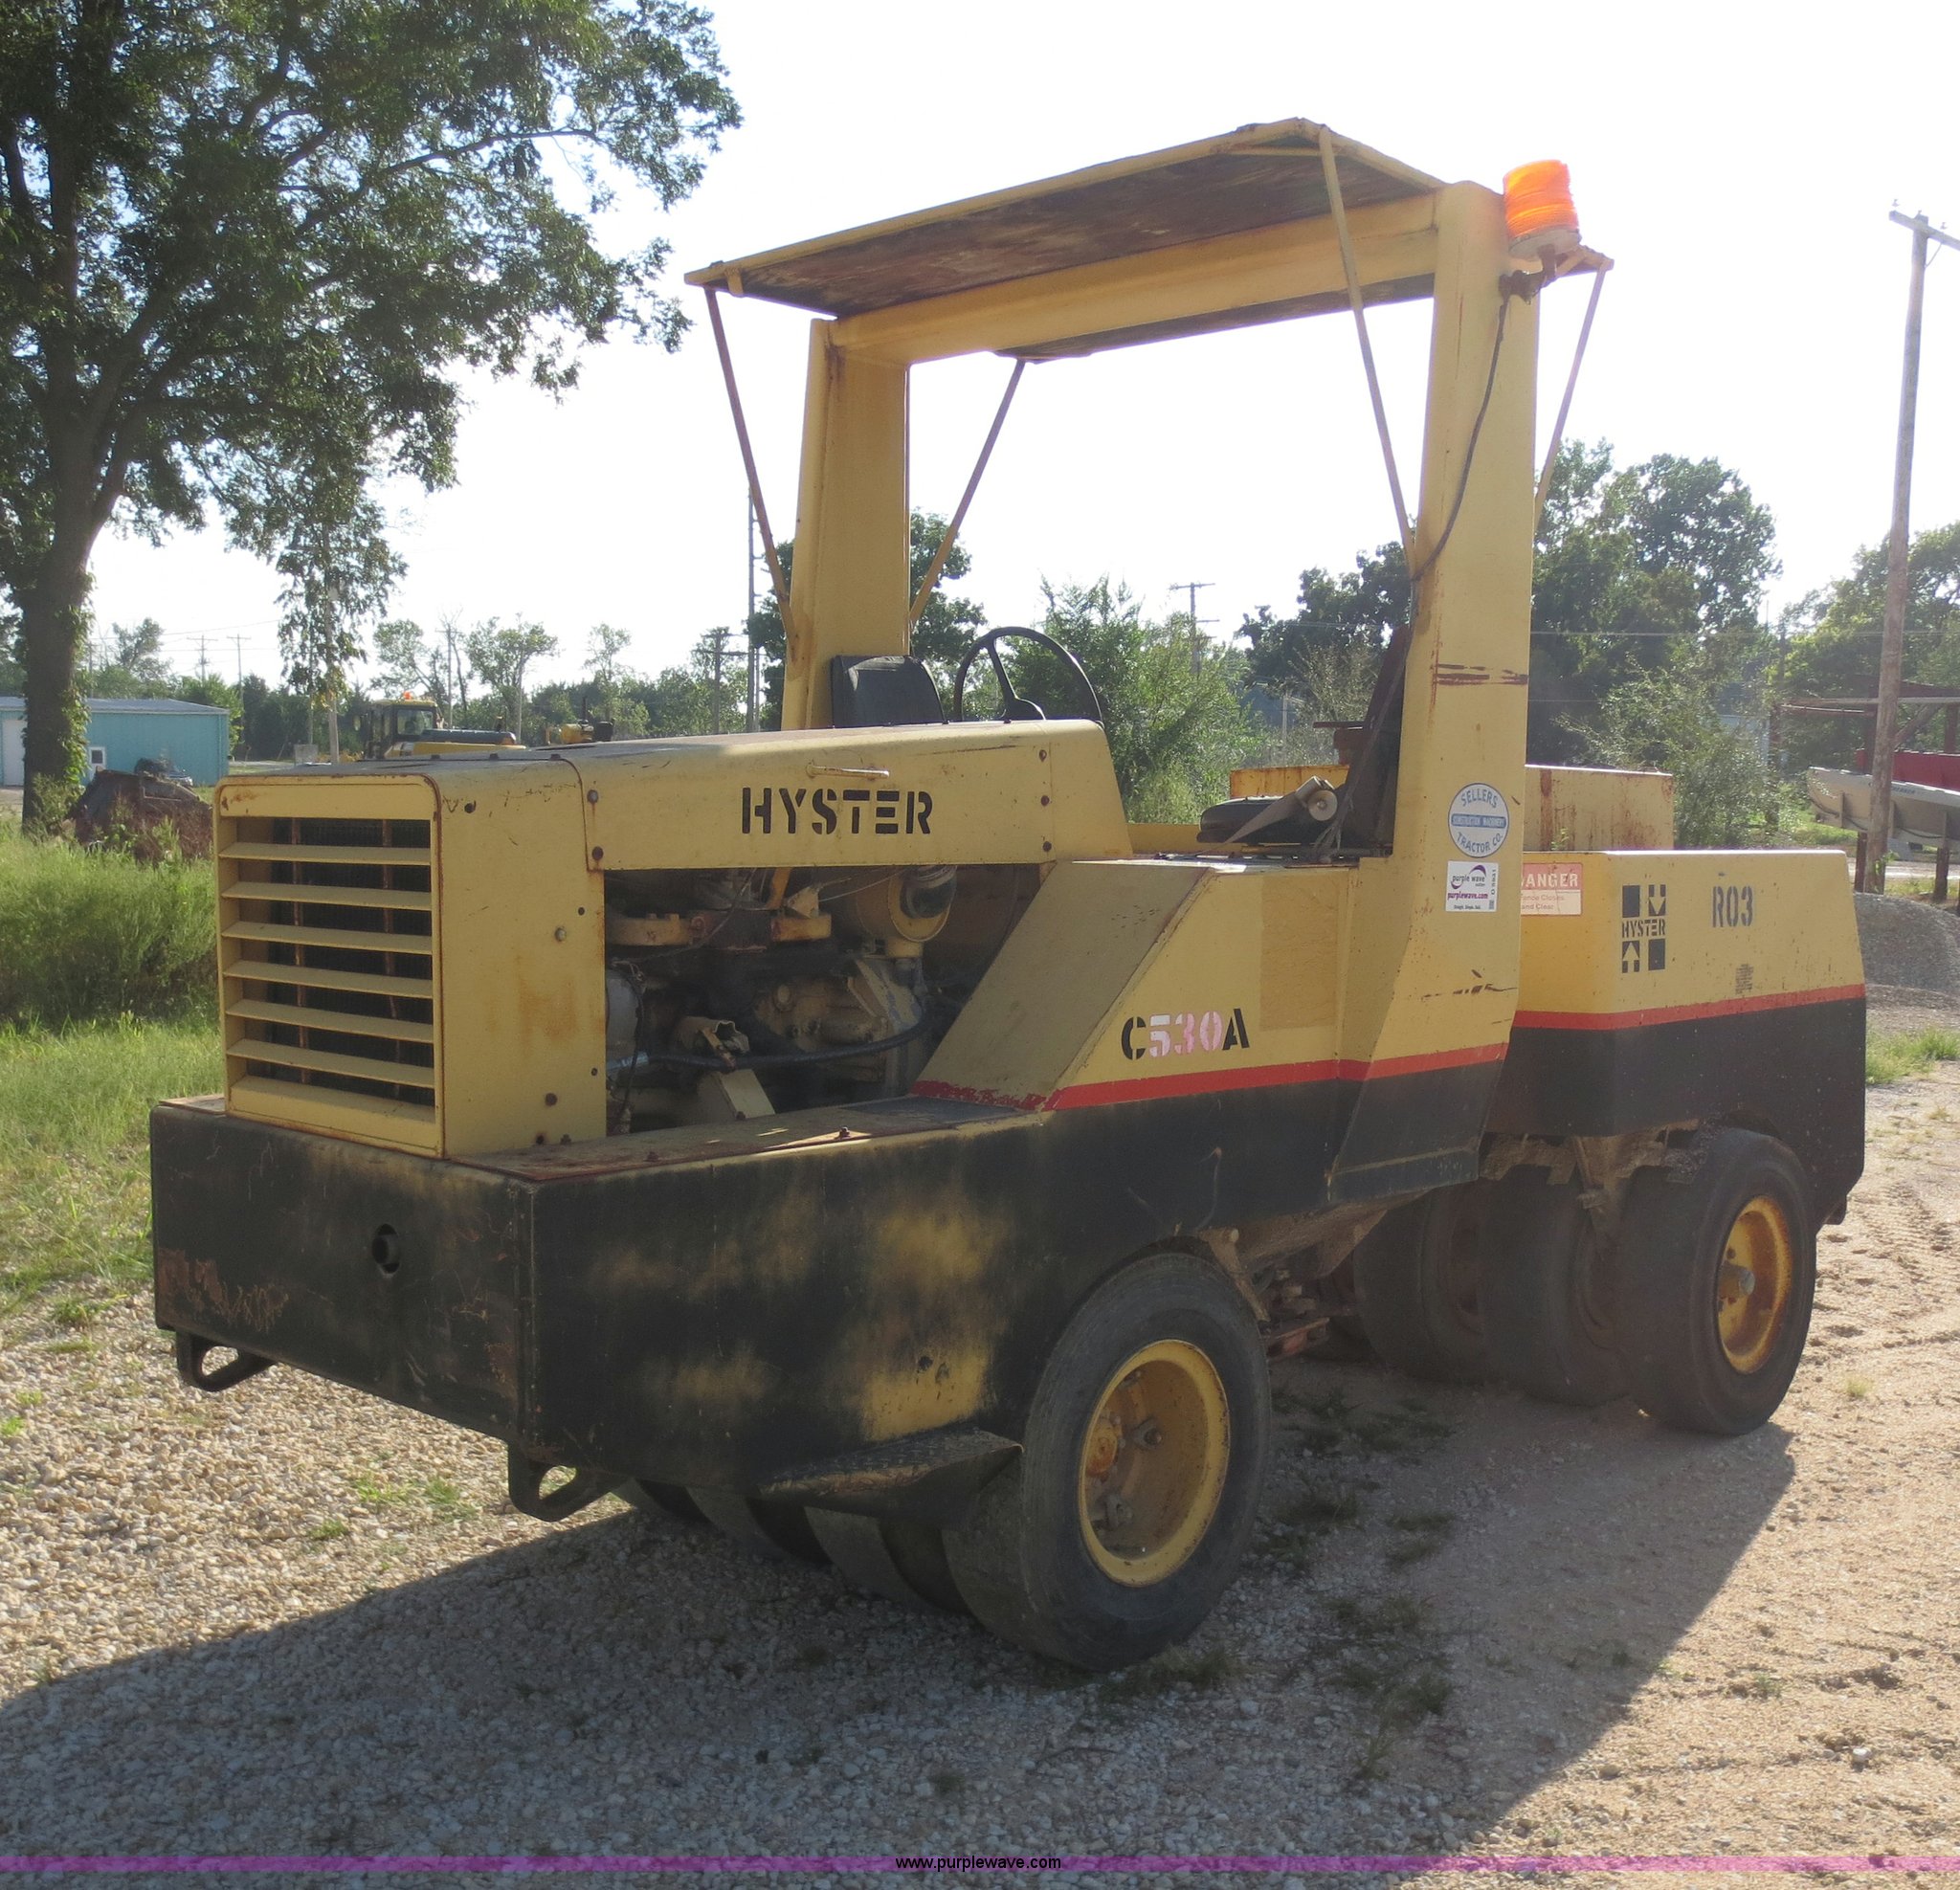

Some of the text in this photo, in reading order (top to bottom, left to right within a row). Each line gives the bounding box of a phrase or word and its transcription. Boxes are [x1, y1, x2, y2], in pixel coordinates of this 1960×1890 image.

[1460, 788, 1499, 809] SELLERS
[742, 788, 932, 834] HYSTER
[1457, 832, 1491, 853] TRACTOR
[1522, 873, 1578, 887] ANGER
[1447, 891, 1488, 901] purplewave.com
[1621, 919, 1666, 938] HYSTER
[1121, 1008, 1250, 1060] C530A
